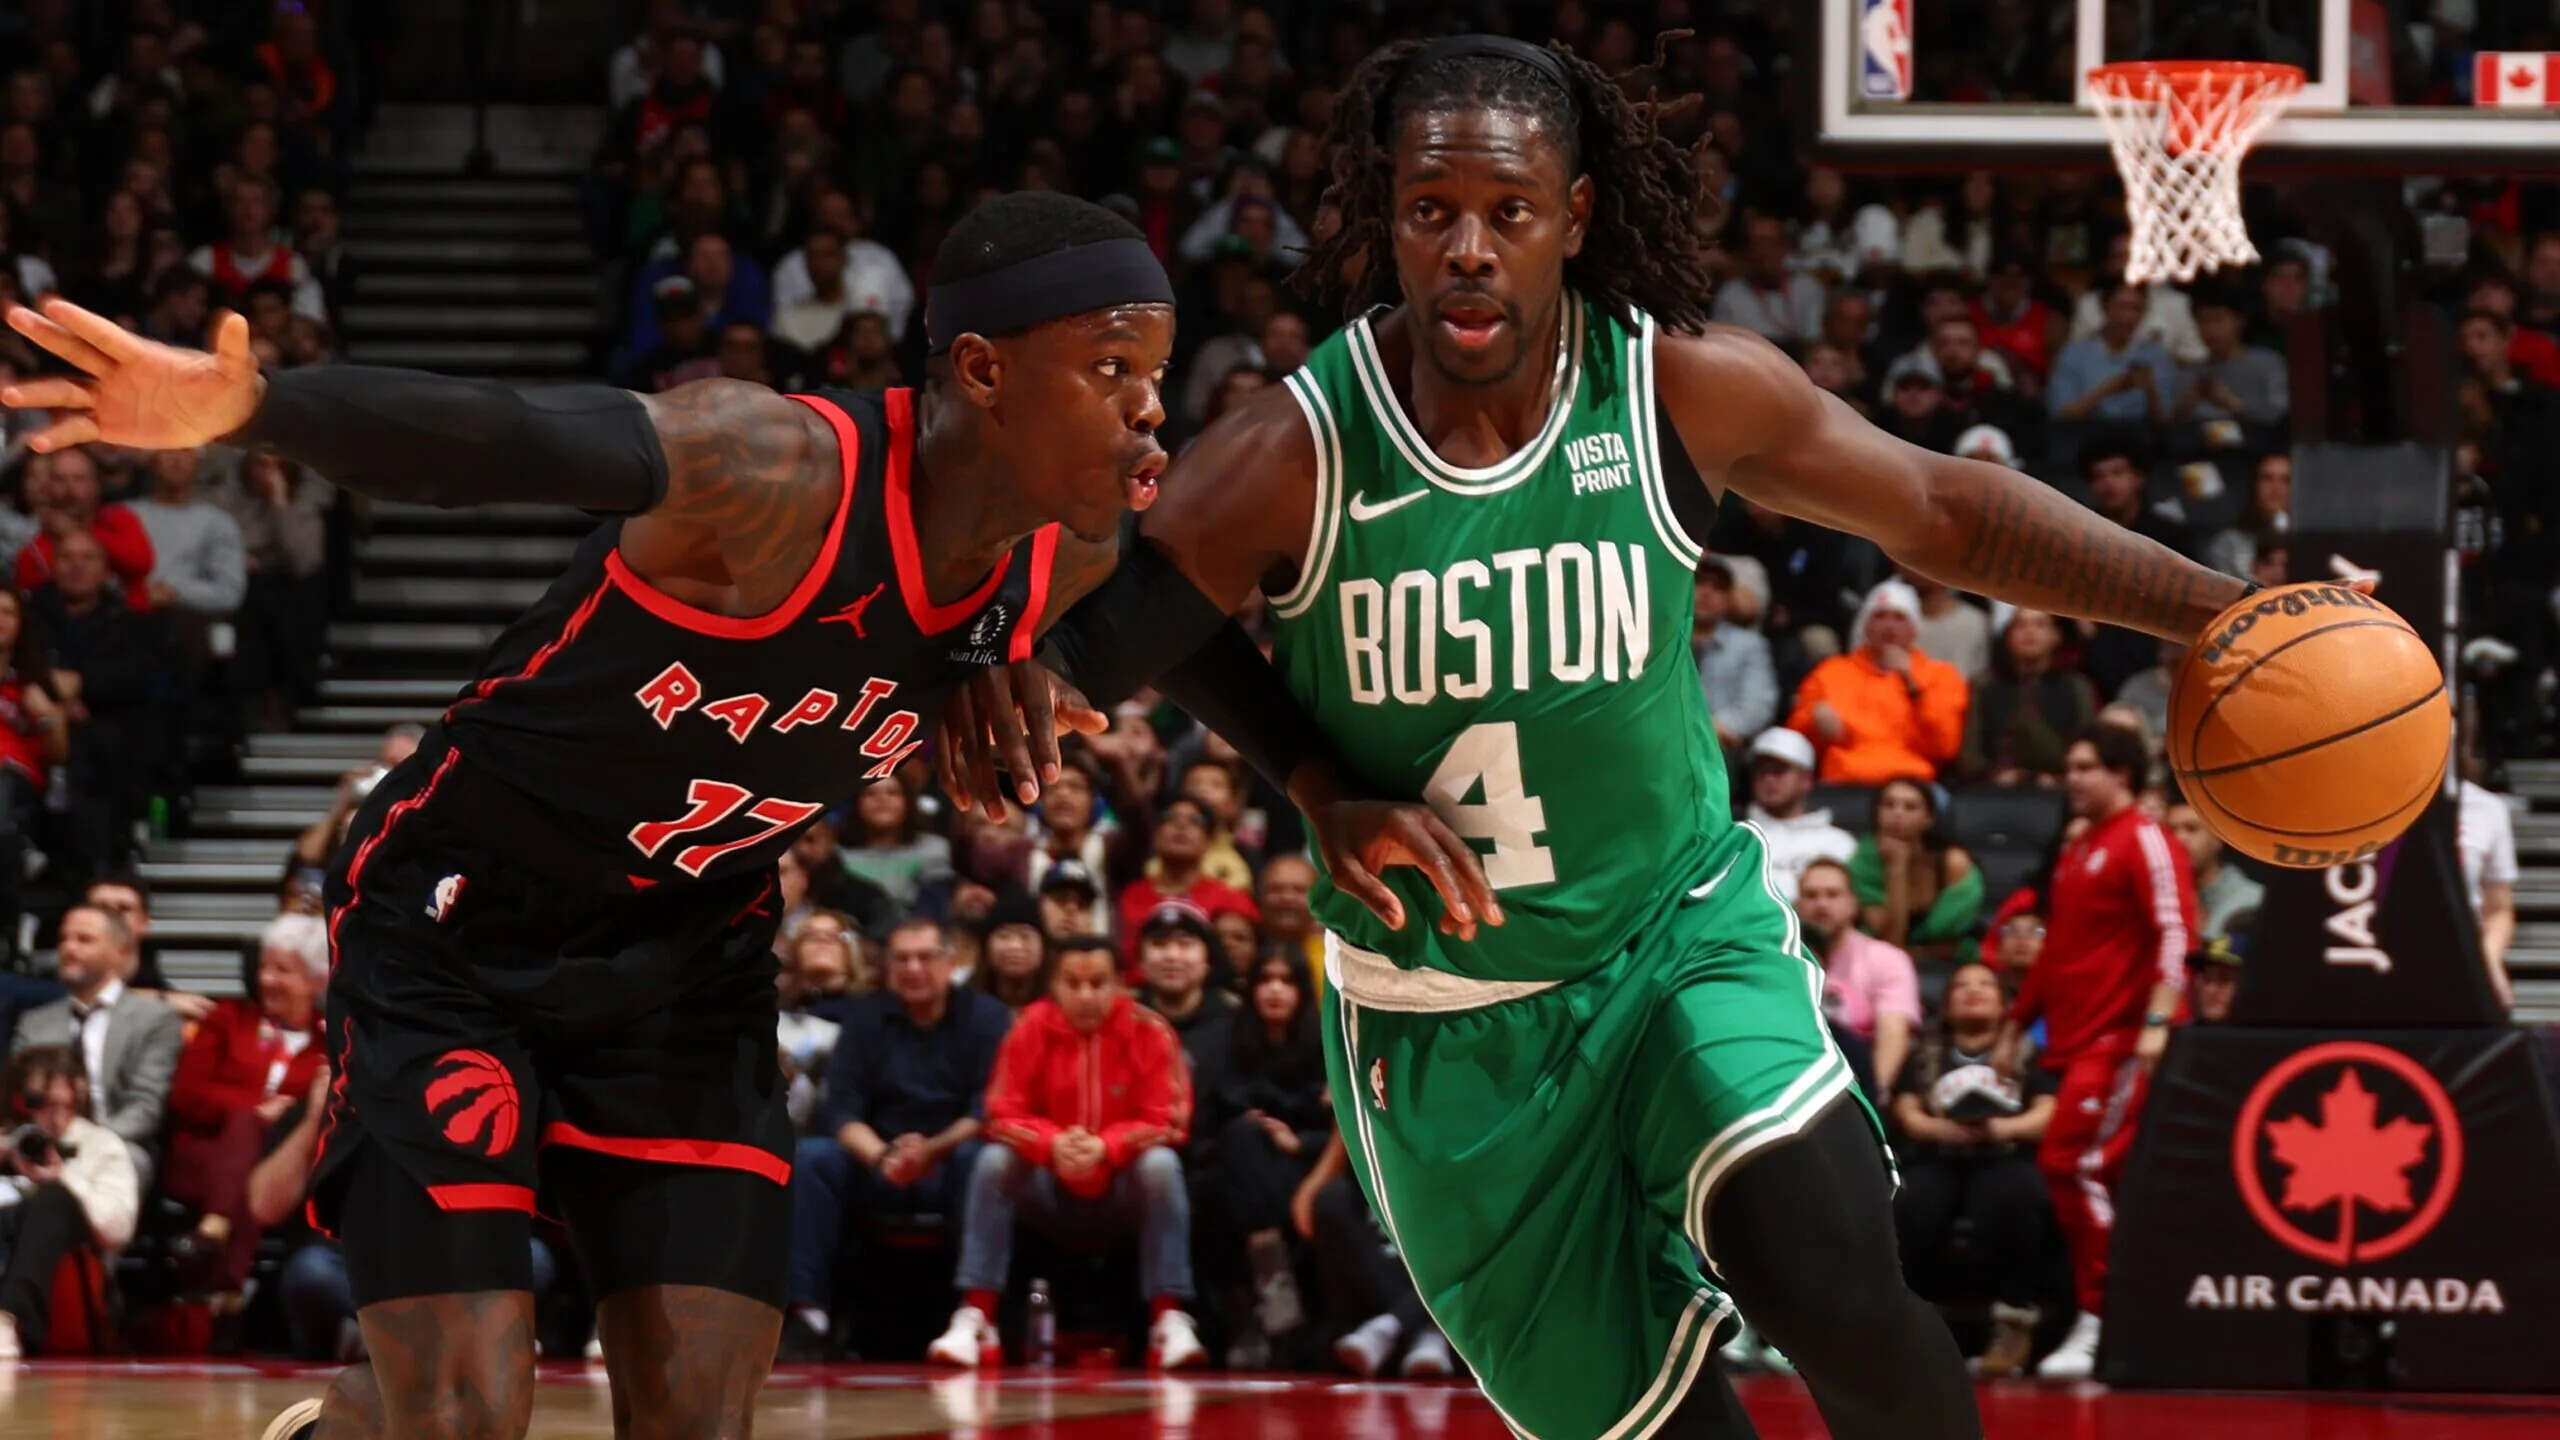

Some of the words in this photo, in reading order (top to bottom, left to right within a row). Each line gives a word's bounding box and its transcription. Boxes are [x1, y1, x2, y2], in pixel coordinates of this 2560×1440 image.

[1564, 432, 1631, 472] VISTA
[1571, 463, 1632, 496] PRINT
[1339, 541, 1651, 705] BOSTON
[971, 649, 998, 665] Life
[1422, 720, 1557, 891] 4
[2324, 851, 2393, 974] JAC
[2186, 1274, 2276, 1308] AIR
[2285, 1275, 2505, 1313] CANADA
